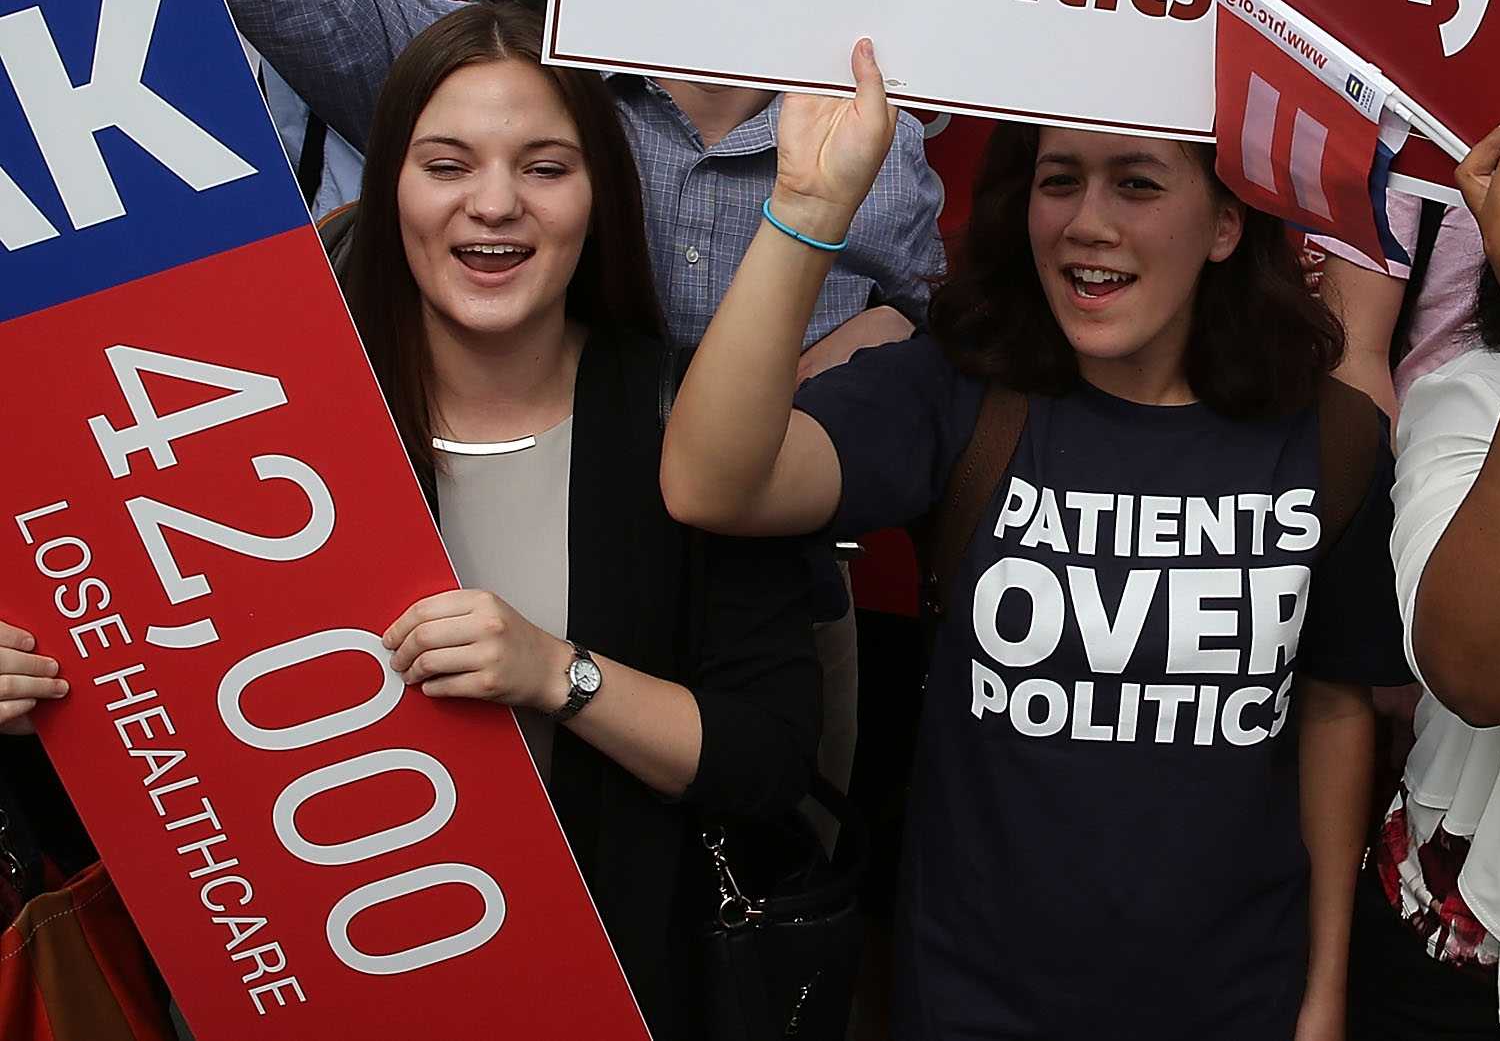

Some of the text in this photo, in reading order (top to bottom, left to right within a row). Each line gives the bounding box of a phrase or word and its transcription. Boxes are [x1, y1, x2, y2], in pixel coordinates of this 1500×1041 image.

[993, 475, 1322, 557] PATIENTS
[87, 343, 507, 976] 42,000
[972, 557, 1312, 675] OVER
[14, 500, 308, 1015] LOSE HEALTHCARE
[970, 658, 1294, 746] POLITICS
